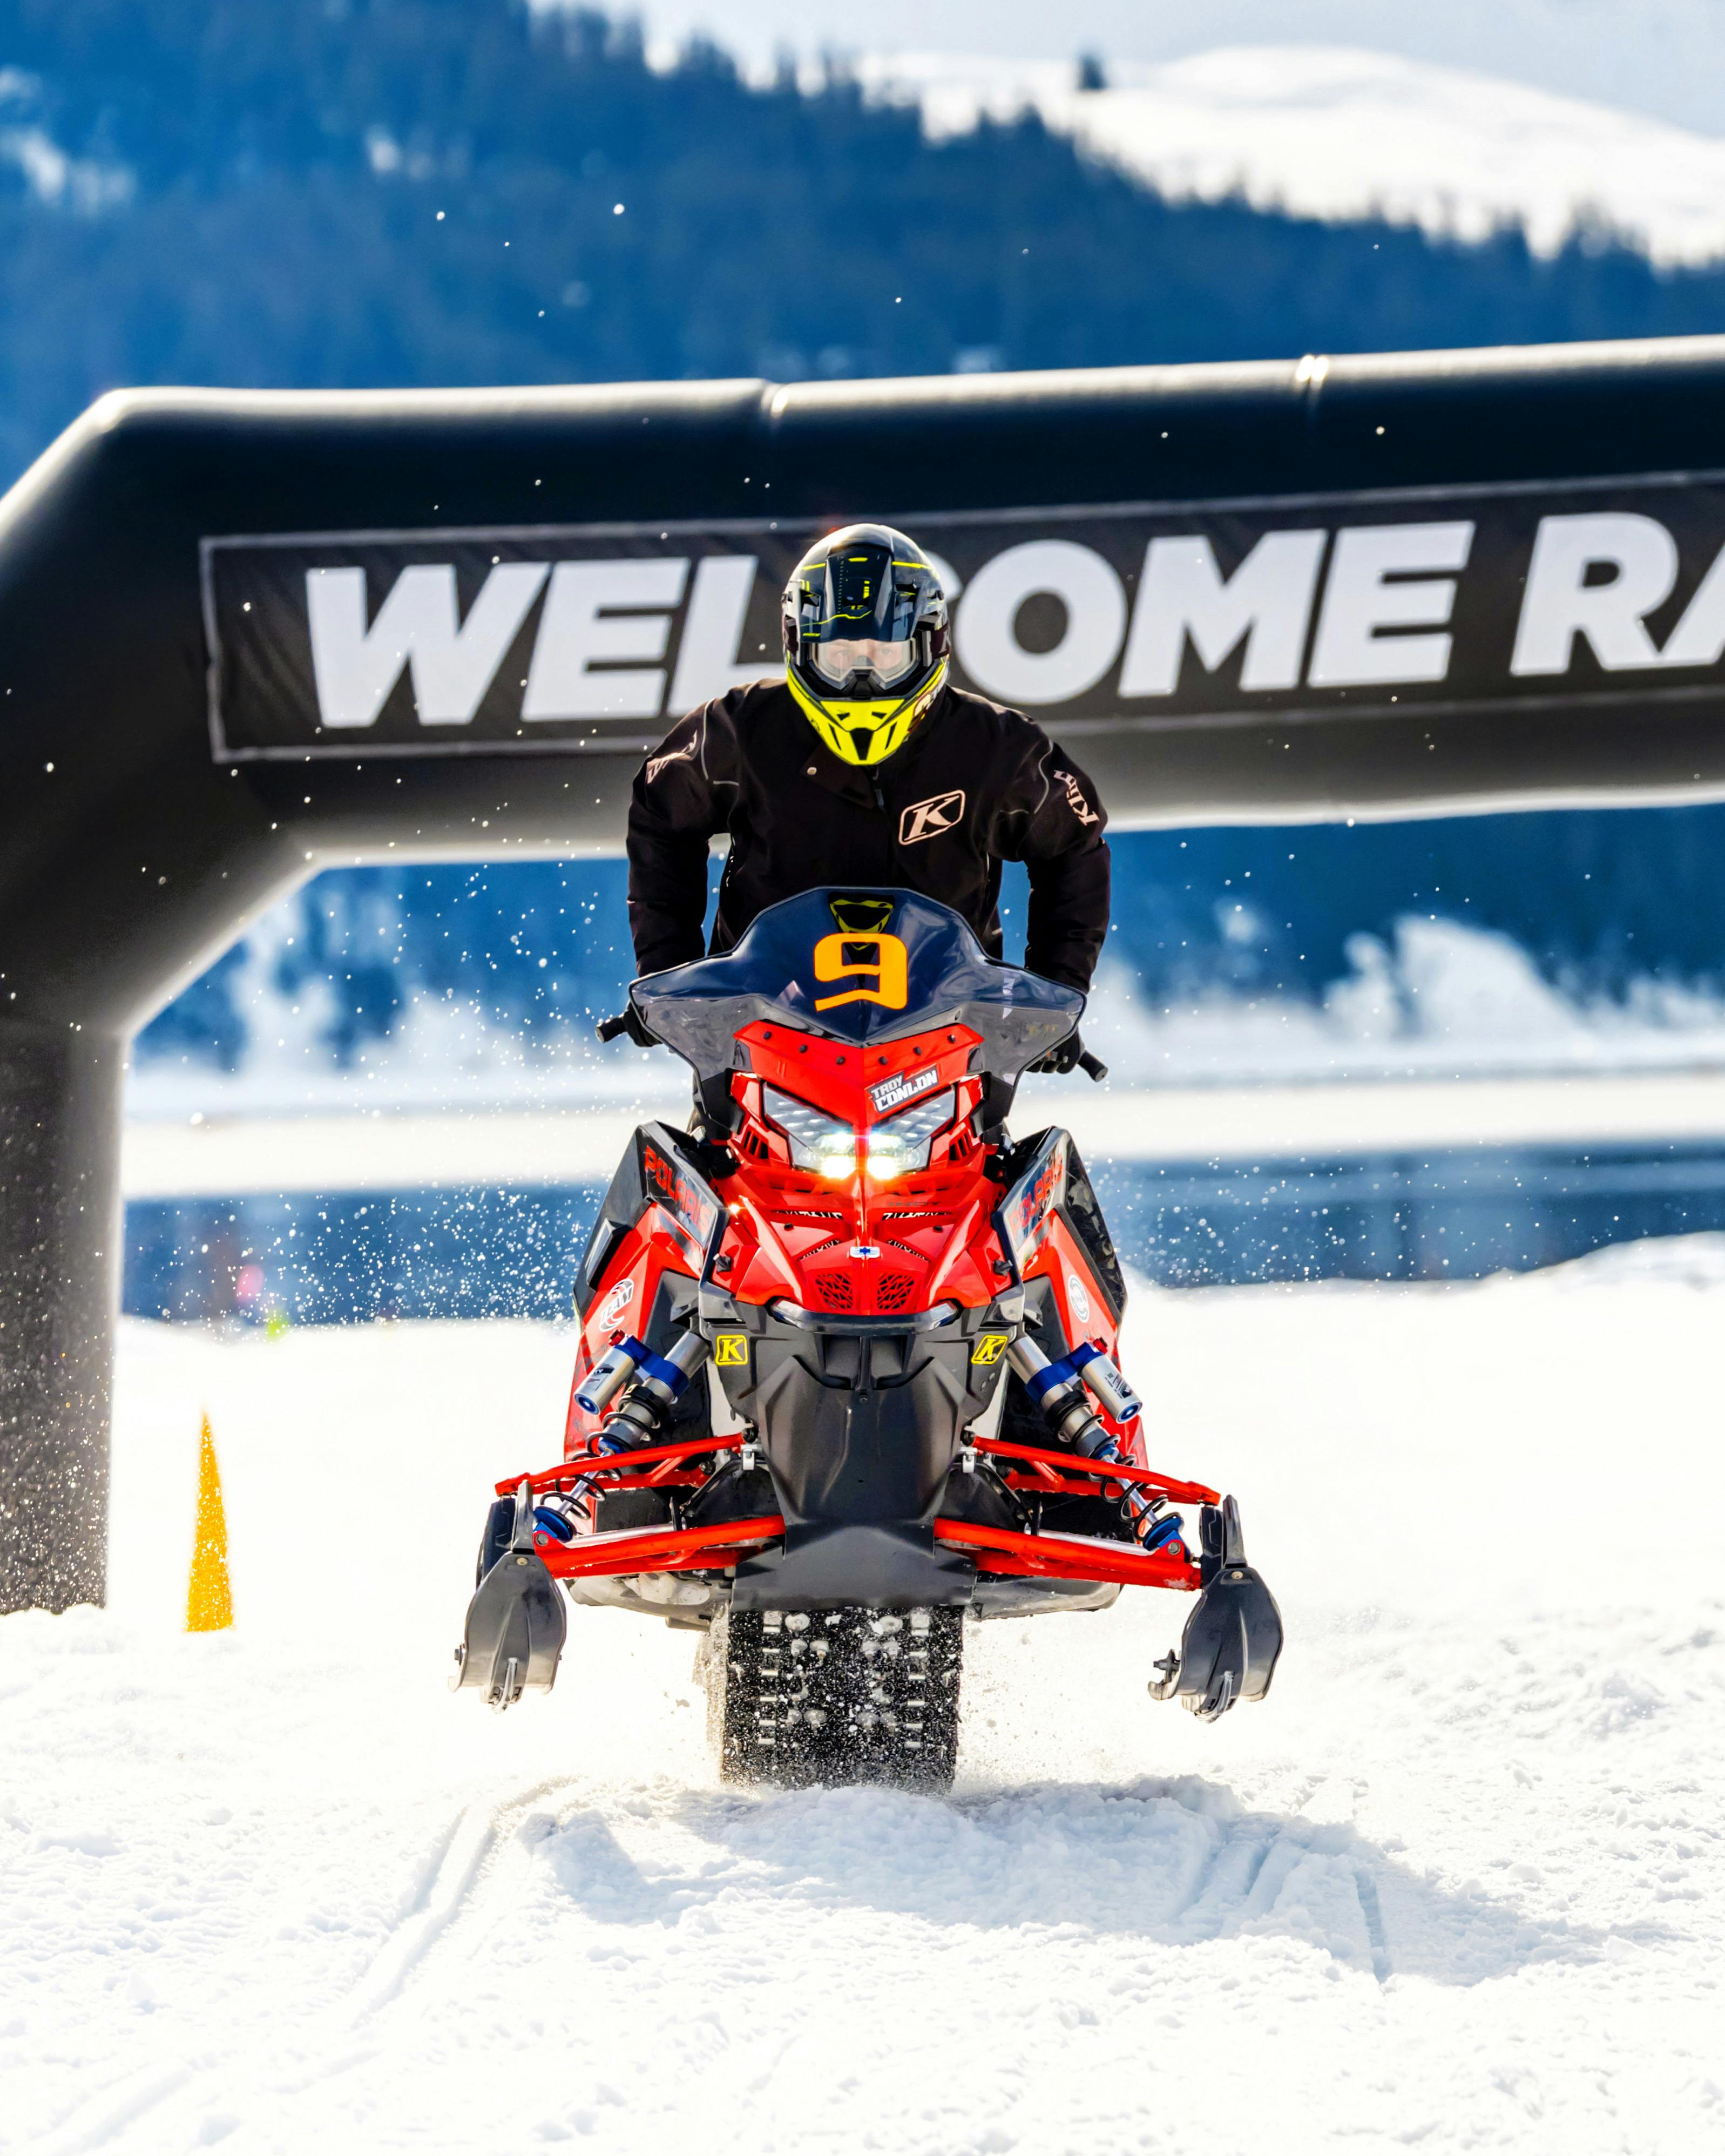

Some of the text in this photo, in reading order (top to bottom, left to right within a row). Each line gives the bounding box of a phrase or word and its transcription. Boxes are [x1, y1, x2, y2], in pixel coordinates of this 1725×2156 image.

[305, 519, 1474, 728] WELOME
[904, 795, 960, 841] K
[814, 932, 908, 1012] 9
[871, 1075, 903, 1099] TROY
[875, 1070, 938, 1111] CONLON
[645, 1145, 712, 1235] POLARIS
[720, 1339, 743, 1361] K
[975, 1339, 1005, 1361] K
